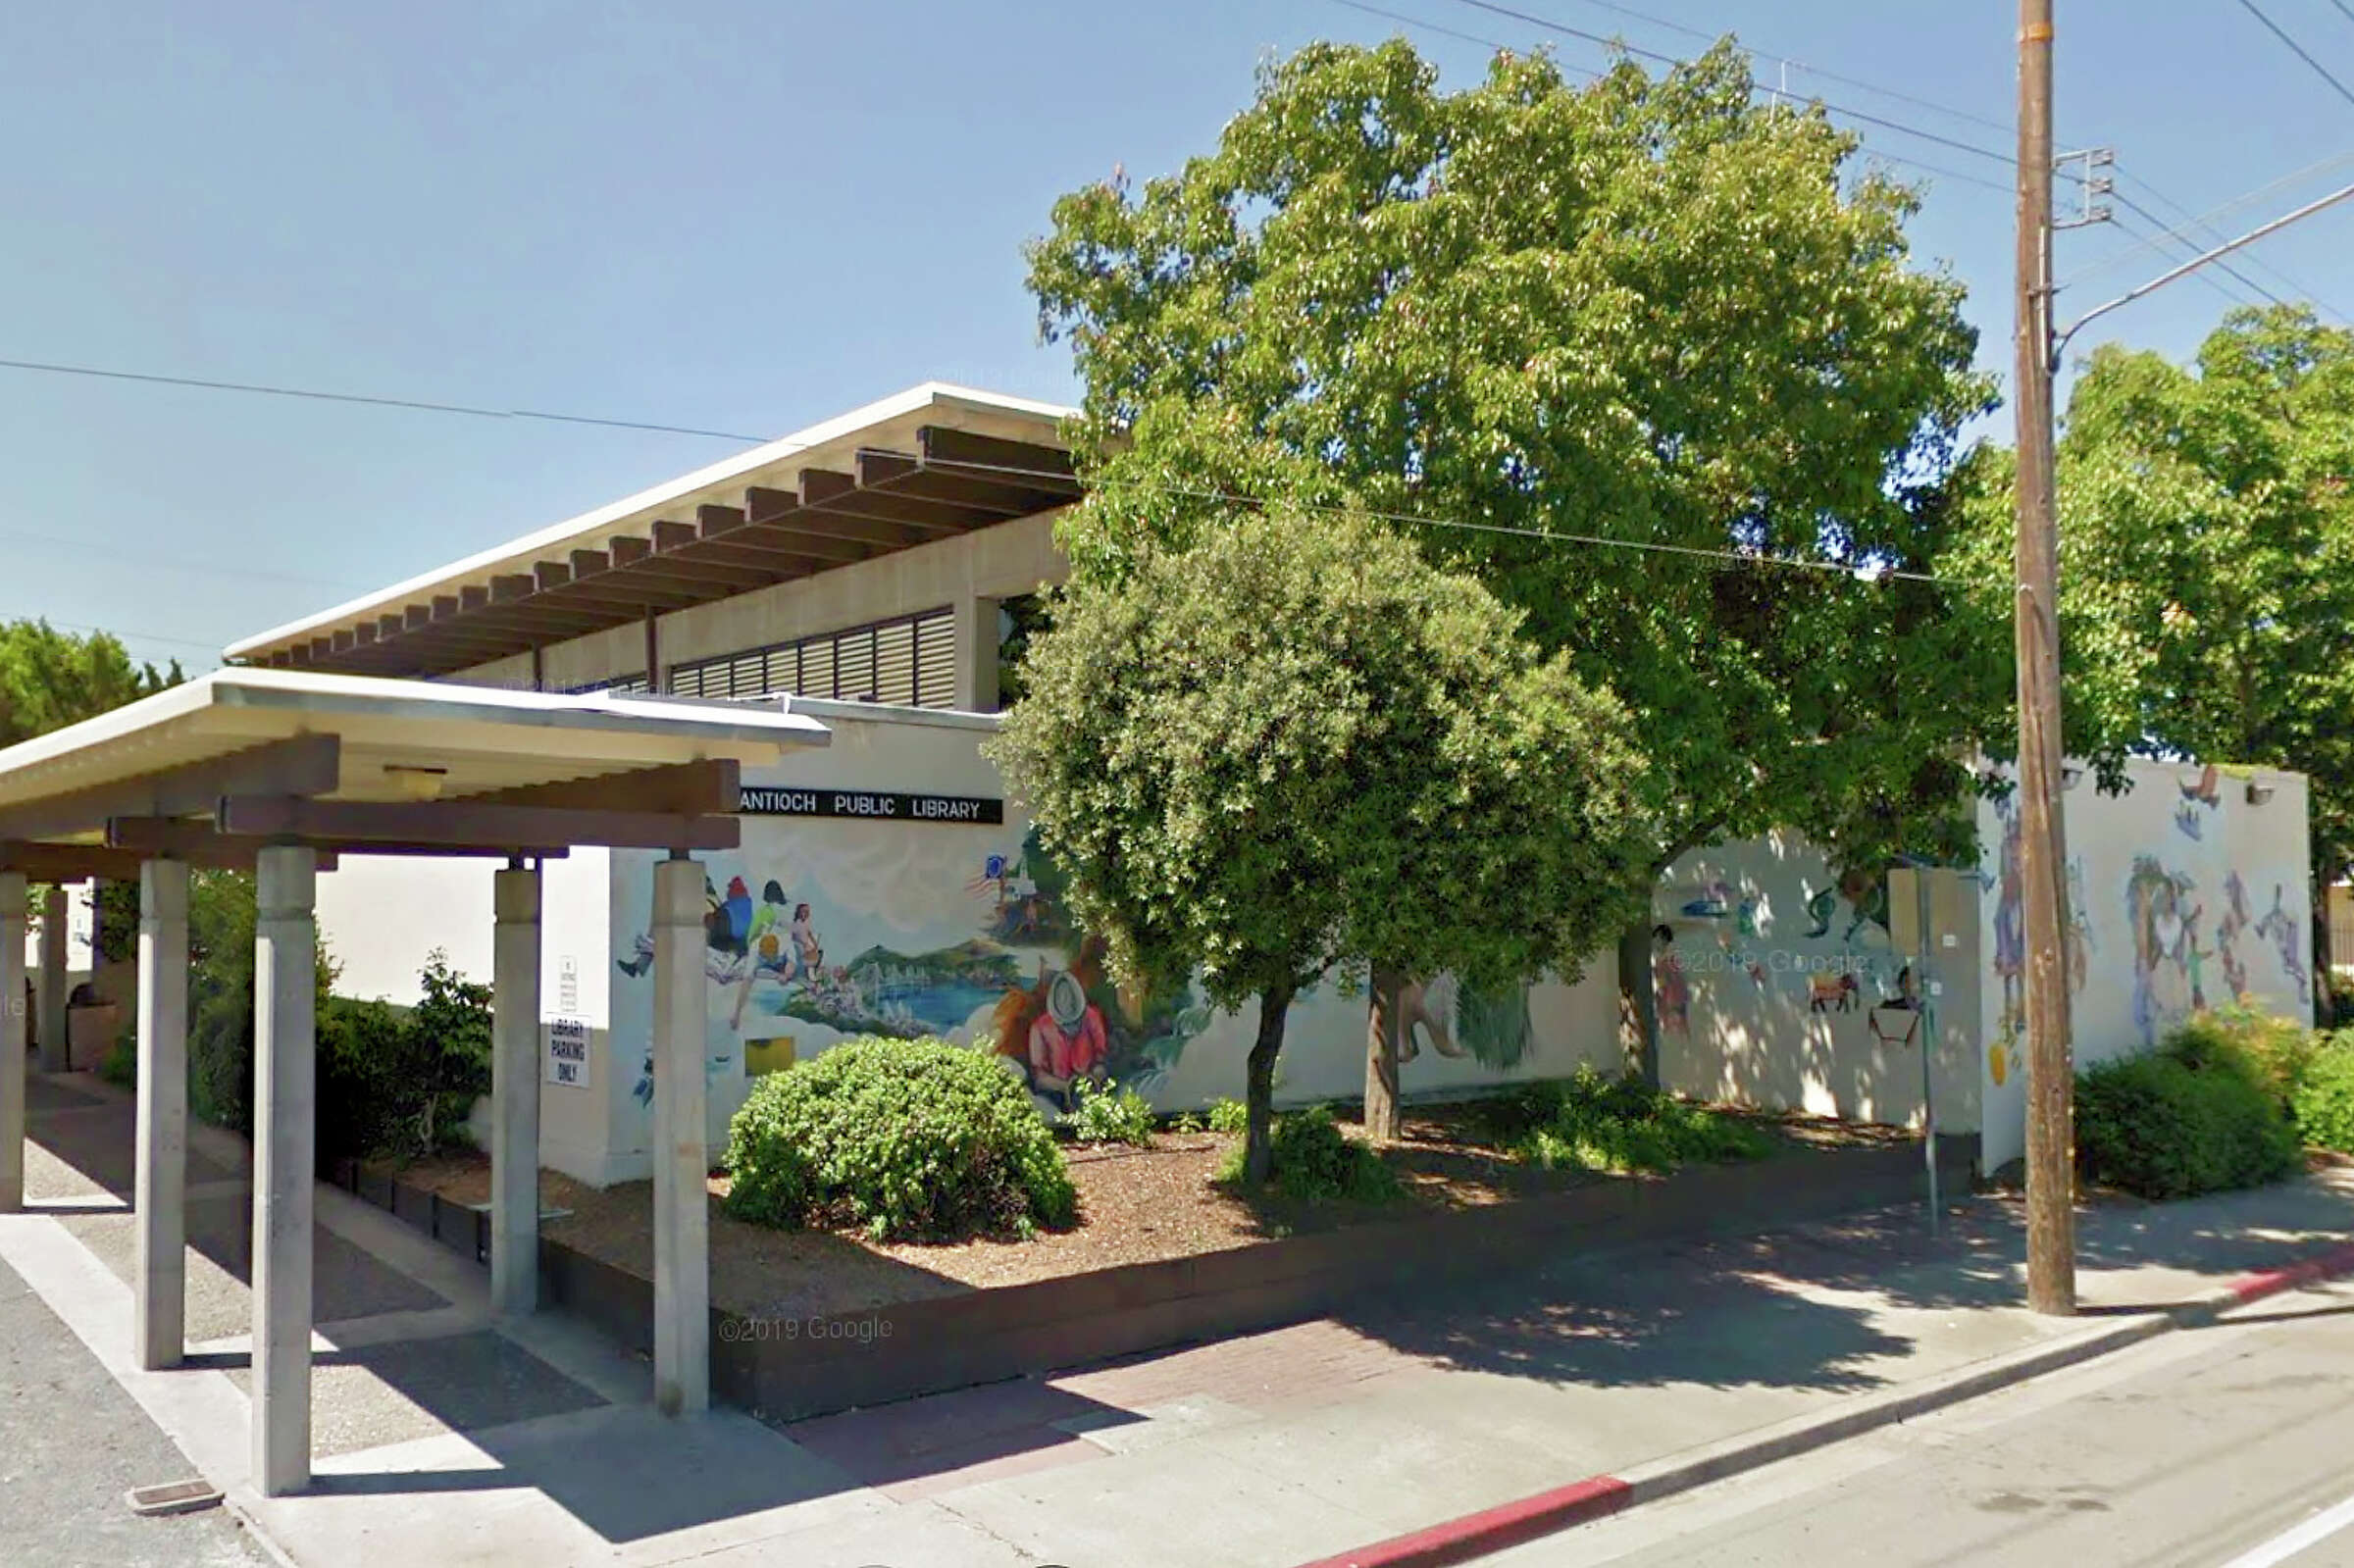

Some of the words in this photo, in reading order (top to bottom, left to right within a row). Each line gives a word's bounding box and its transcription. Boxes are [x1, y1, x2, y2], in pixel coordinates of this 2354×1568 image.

[740, 791, 816, 812] ANTIOCH
[835, 795, 895, 816] PUBLIC
[912, 799, 981, 820] LIBRARY
[551, 1039, 585, 1061] PARKING
[558, 1062, 578, 1082] ONLY
